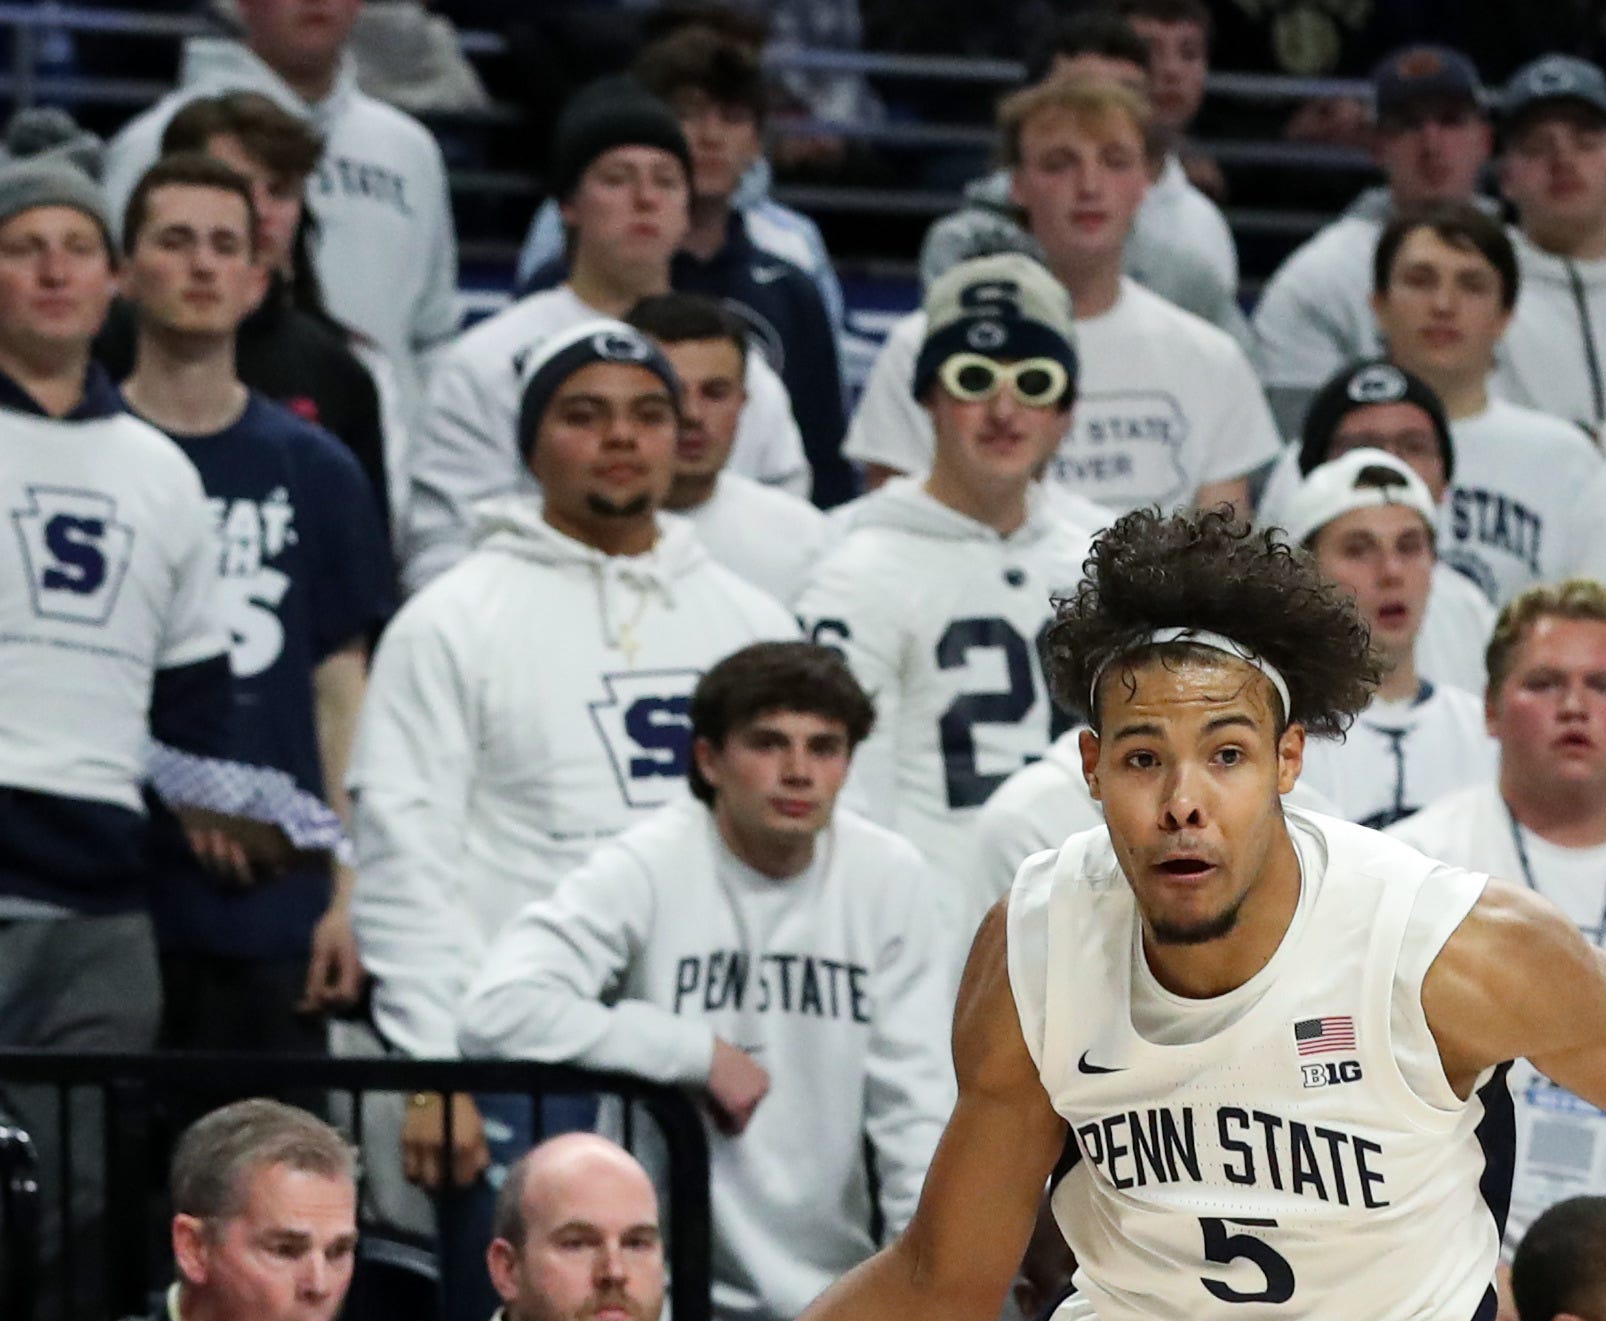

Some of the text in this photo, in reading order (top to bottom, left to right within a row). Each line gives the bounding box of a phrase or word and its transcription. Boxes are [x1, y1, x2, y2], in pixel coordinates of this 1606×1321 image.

[1055, 453, 1133, 481] EVER
[44, 513, 106, 595] S
[936, 615, 1060, 809] 2
[1077, 1106, 1391, 1209] PENN STATE
[1198, 1216, 1296, 1304] 5
